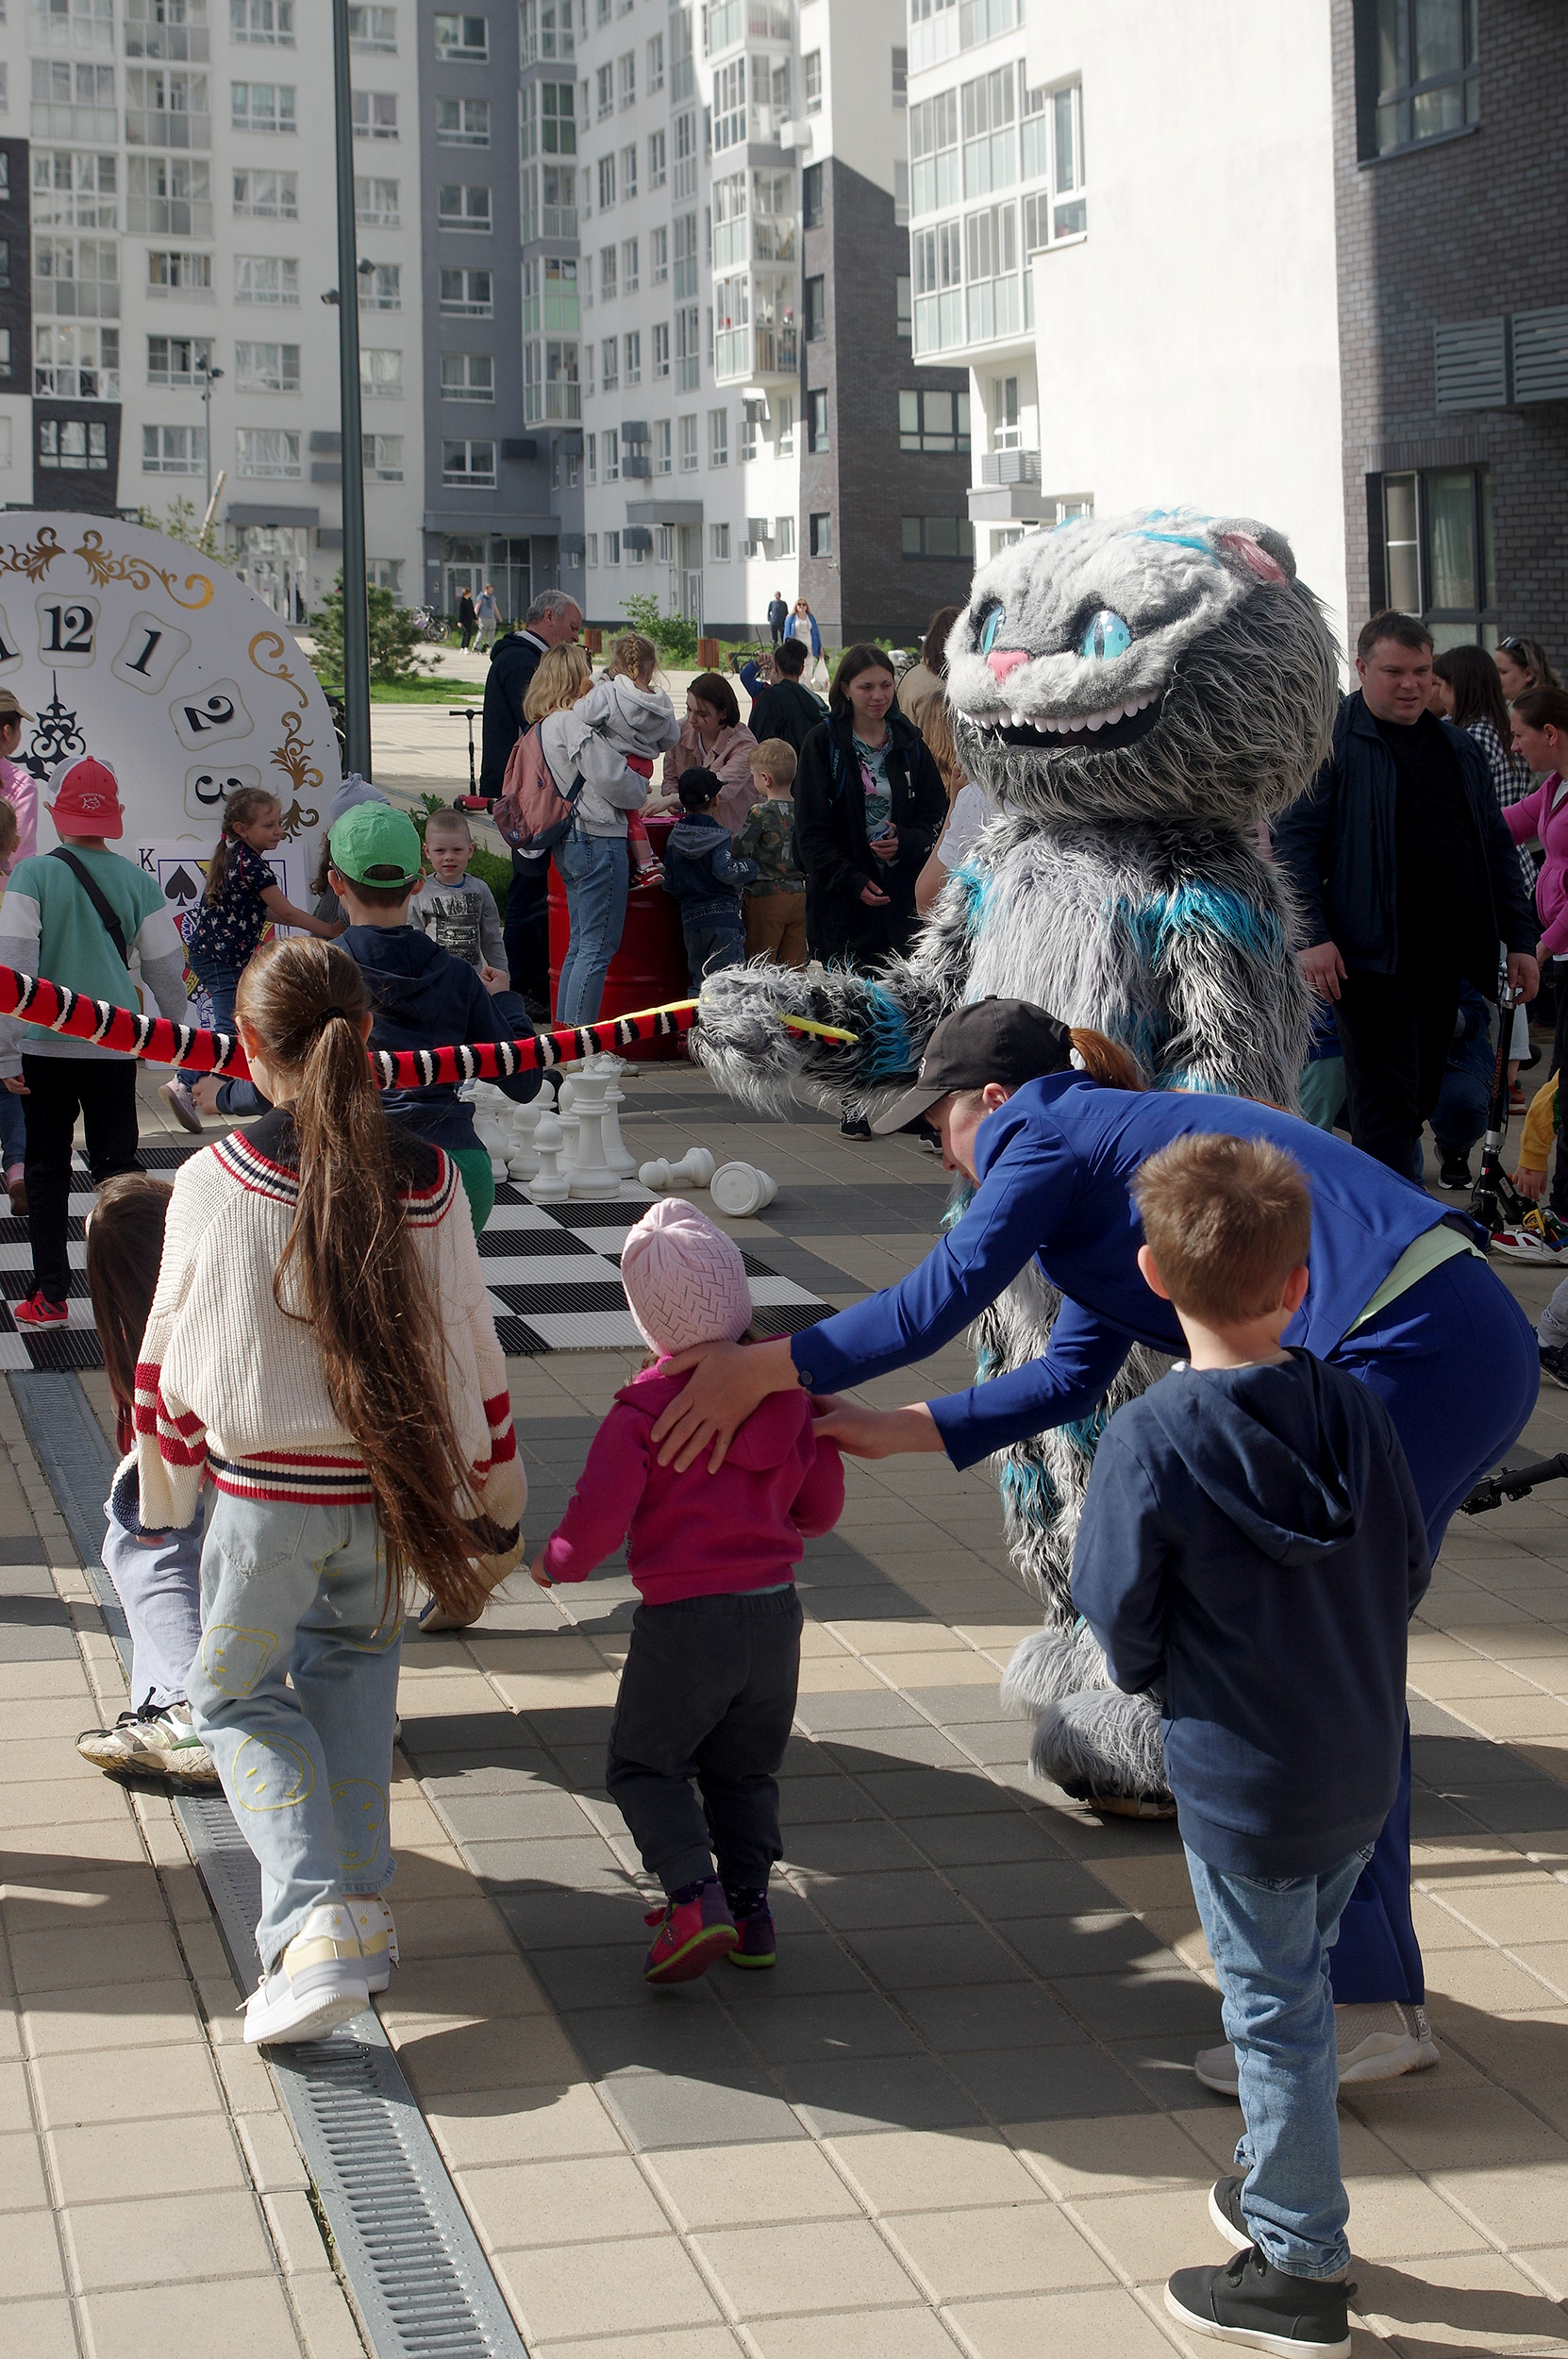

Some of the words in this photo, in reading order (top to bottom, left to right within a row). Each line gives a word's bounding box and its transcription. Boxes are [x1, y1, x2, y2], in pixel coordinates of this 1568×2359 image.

[42, 605, 92, 652] 12
[125, 628, 161, 677] 1
[183, 695, 234, 732] 2
[195, 776, 242, 805] 3
[139, 848, 156, 872] K
